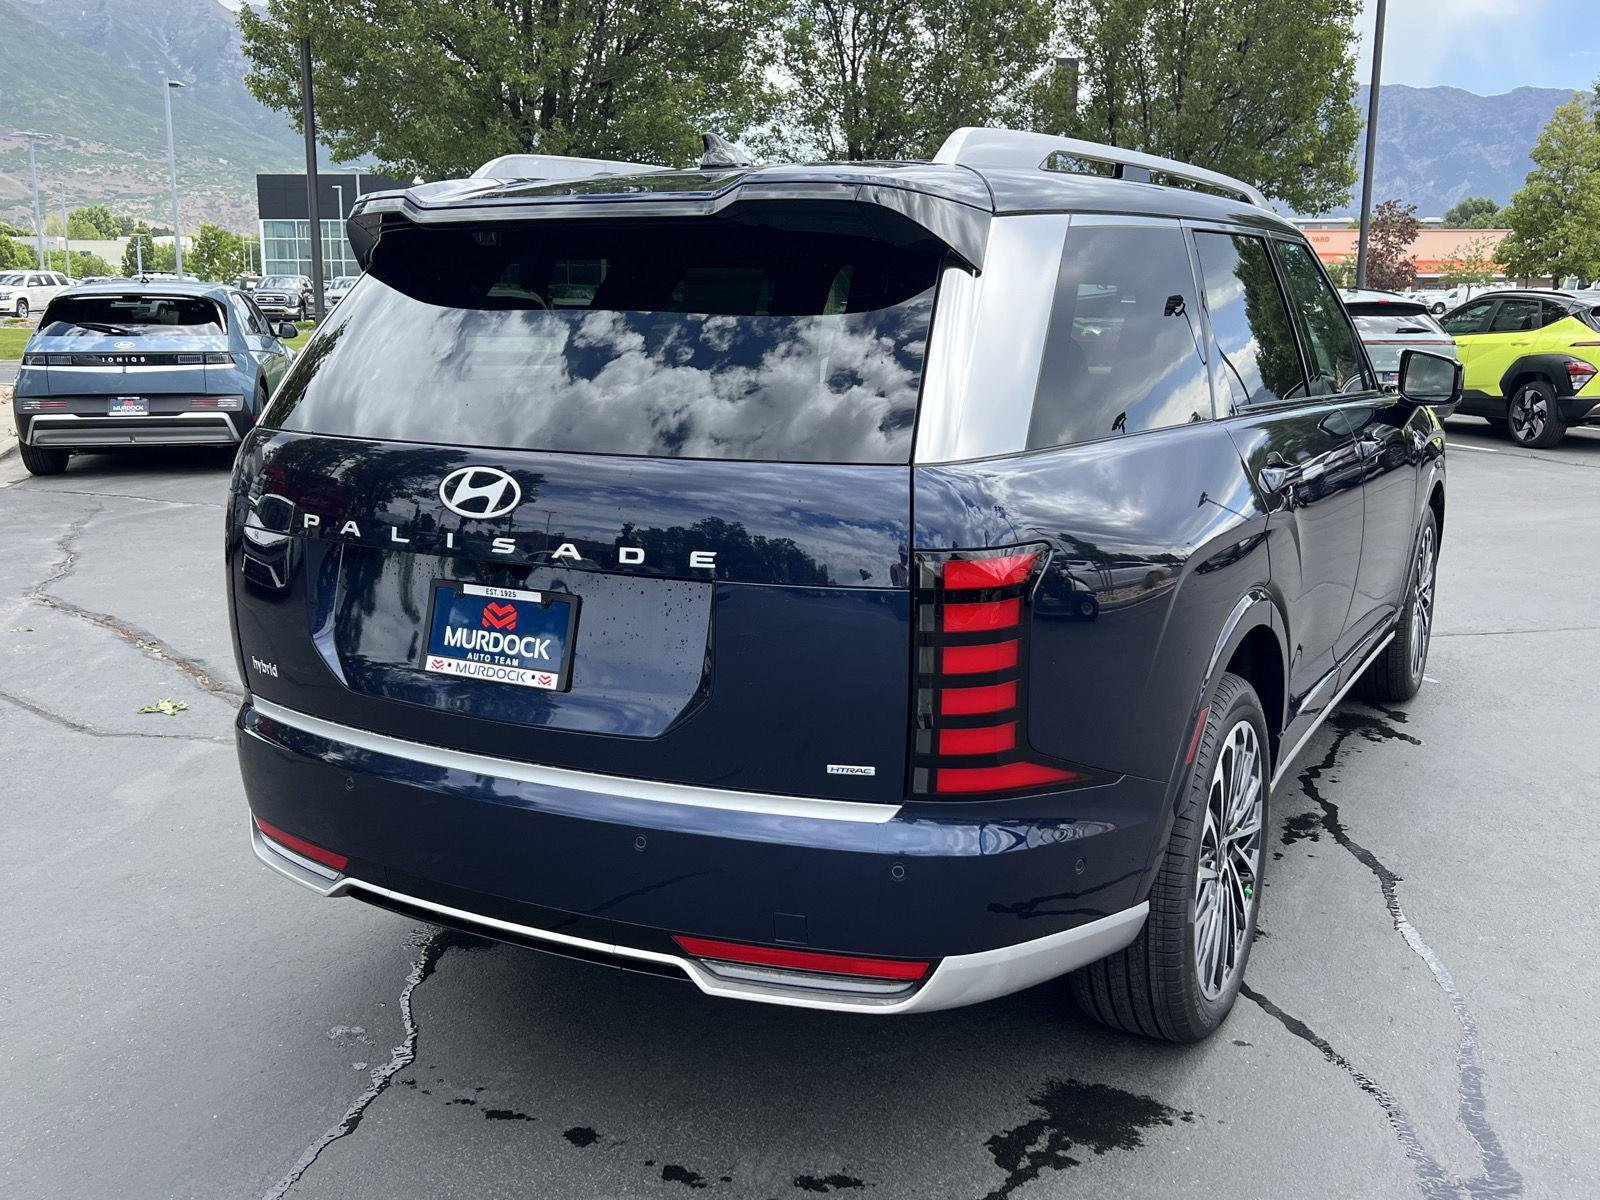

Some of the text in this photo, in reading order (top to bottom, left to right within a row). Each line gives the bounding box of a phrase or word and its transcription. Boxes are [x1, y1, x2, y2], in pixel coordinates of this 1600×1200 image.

[303, 513, 718, 569] PALISADE
[485, 588, 517, 598] EST. 1925
[443, 625, 551, 660] MURDOCK
[251, 655, 279, 678] hybrid
[467, 652, 519, 666] AUTO TEAM
[455, 661, 526, 683] MURDOCK
